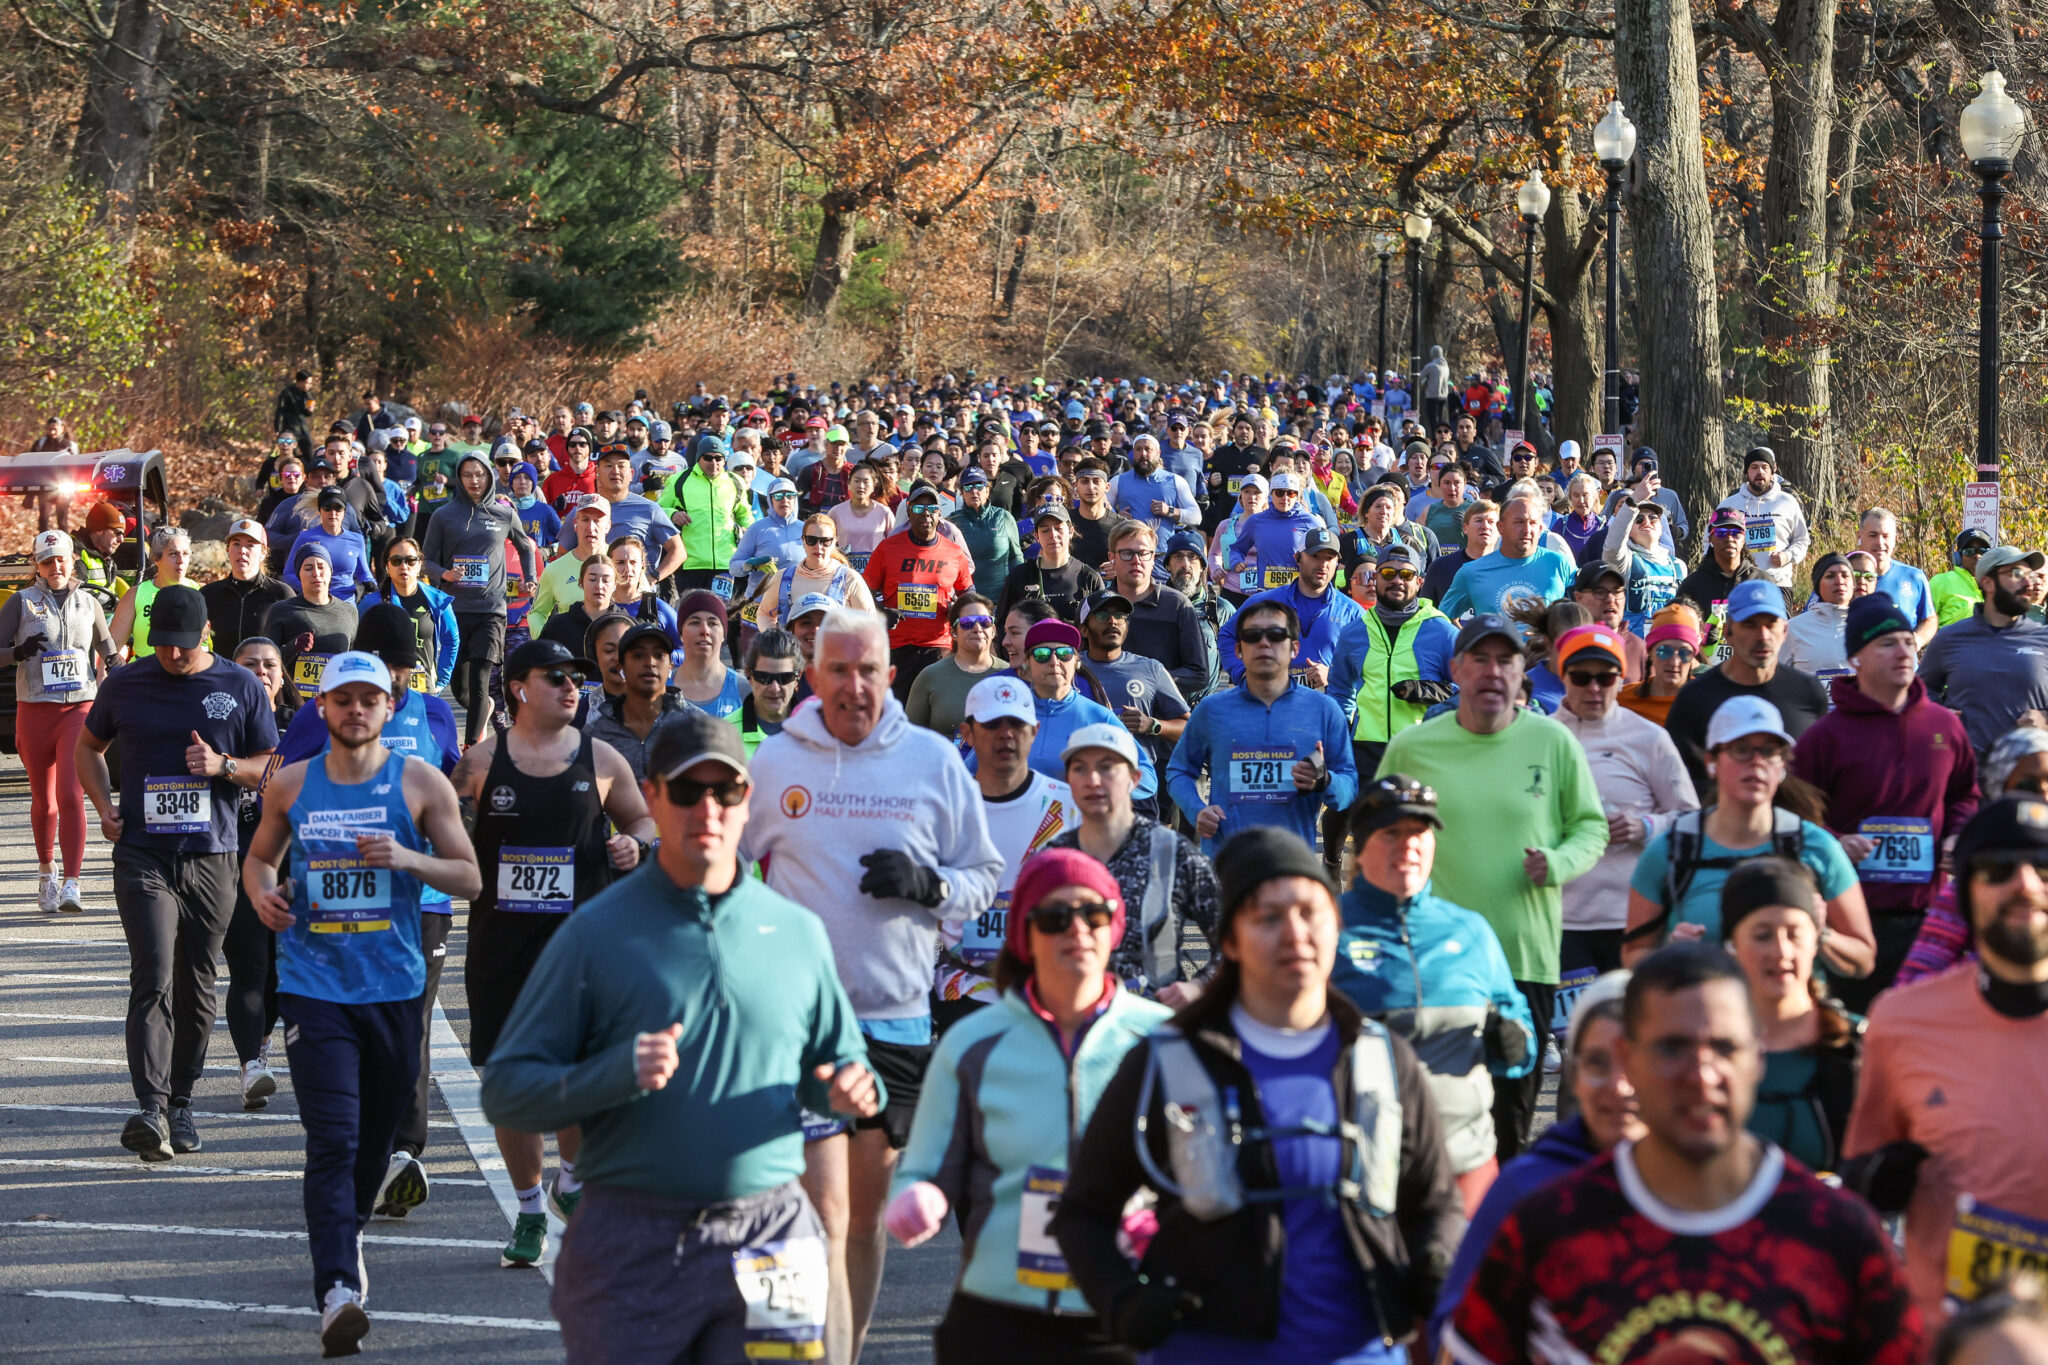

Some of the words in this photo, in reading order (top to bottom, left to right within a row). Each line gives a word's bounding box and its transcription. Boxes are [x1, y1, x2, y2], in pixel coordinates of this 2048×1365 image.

[1966, 488, 1977, 496] TOW
[1979, 487, 1997, 495] ZONE
[1974, 501, 1986, 509] NO
[1749, 527, 1770, 541] 9769
[904, 592, 930, 607] 6596
[298, 655, 325, 663] BOSTON
[404, 717, 419, 726] NB
[380, 739, 413, 748] FARBER
[1241, 762, 1282, 784] 5731
[147, 782, 185, 791] BOSTON
[185, 781, 209, 789] HALF
[371, 784, 392, 795] NB
[572, 781, 590, 791] NB
[156, 791, 200, 815] 3348
[816, 792, 866, 806] SOUTH
[869, 796, 916, 810] SHORE
[312, 811, 382, 824] DANA-FARBER
[814, 806, 845, 818] HALF
[848, 808, 915, 822] MARATHON
[301, 827, 341, 839] CANCER
[1861, 824, 1905, 833] BOSTON
[1907, 825, 1929, 834] HALF
[1873, 836, 1920, 861] 7630
[310, 858, 357, 869] BOSTON
[502, 854, 544, 864] BOSTON
[545, 855, 571, 863] HALF
[511, 865, 560, 890] 2872
[322, 871, 376, 899] 8876
[977, 912, 1006, 938] 94
